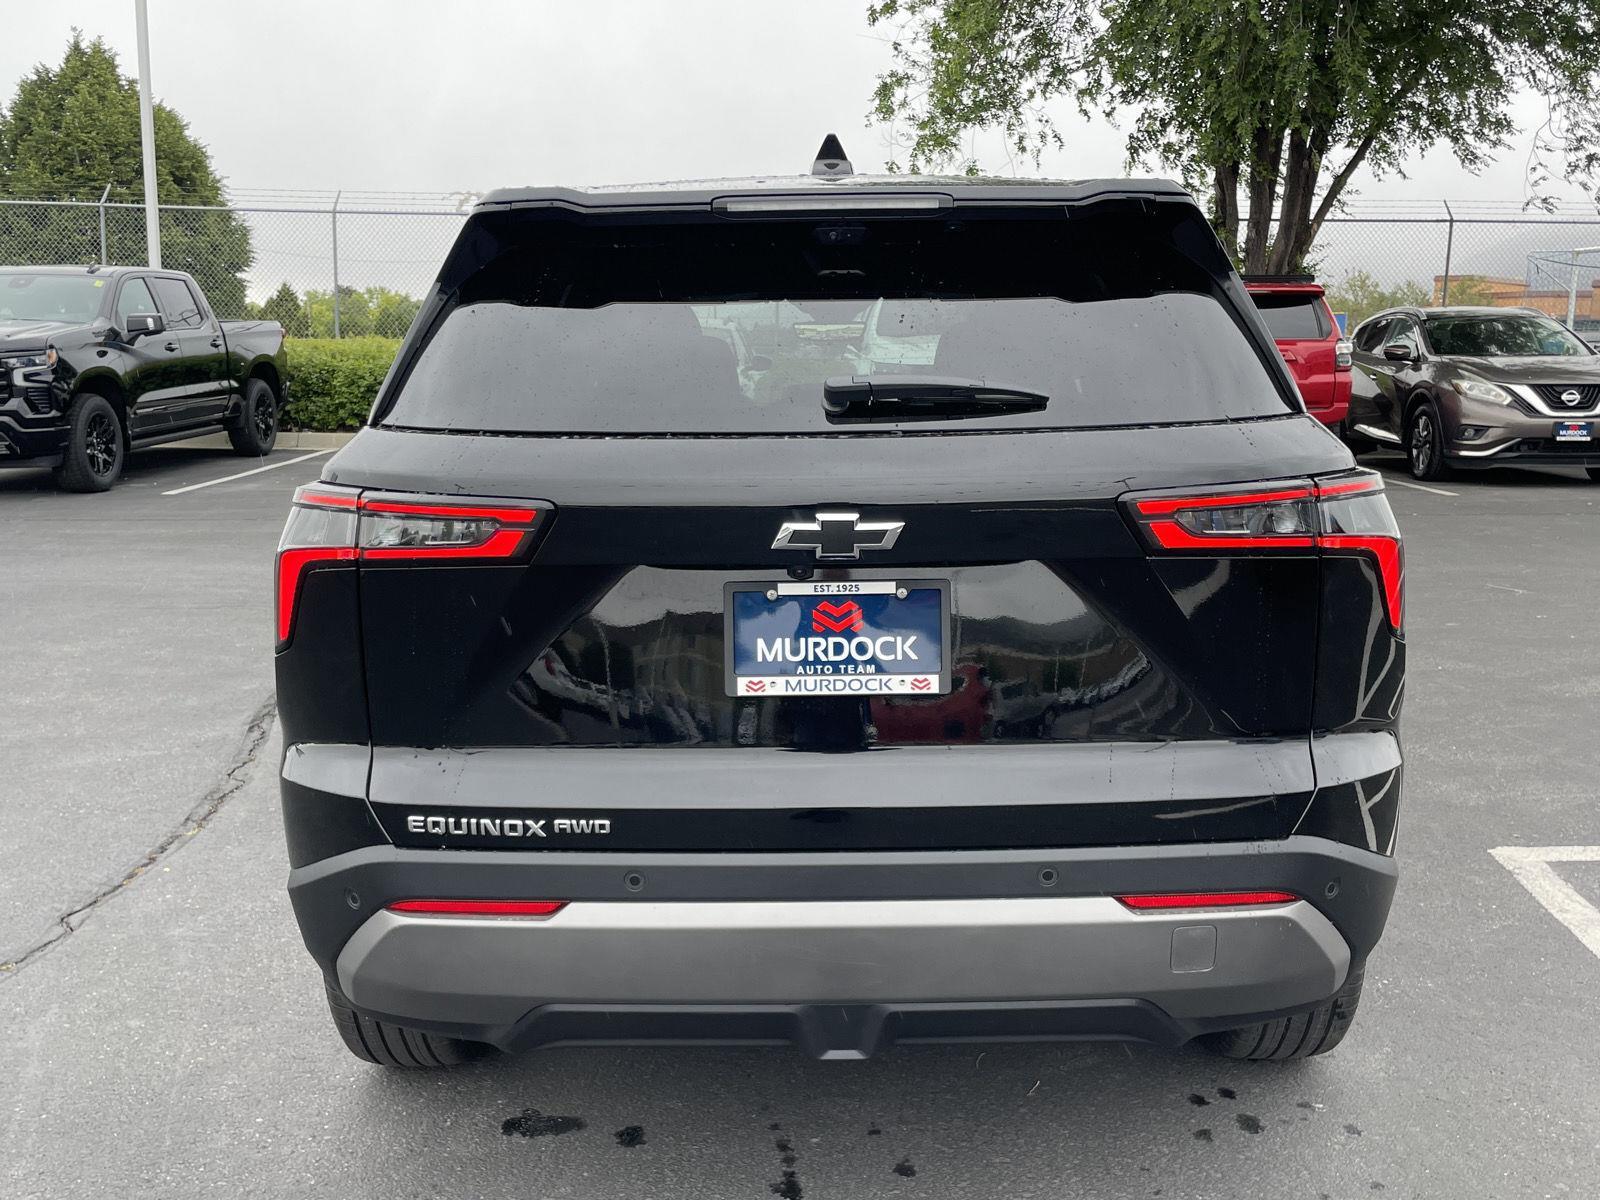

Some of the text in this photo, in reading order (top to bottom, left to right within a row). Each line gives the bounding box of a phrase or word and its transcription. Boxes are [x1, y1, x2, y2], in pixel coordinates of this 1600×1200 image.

[813, 584, 860, 593] EST. 1925
[756, 636, 919, 662] MURDOCK
[796, 664, 876, 674] AUTO TEAM
[785, 678, 893, 692] MURDOCK
[407, 815, 611, 837] EQUINOX AWD
